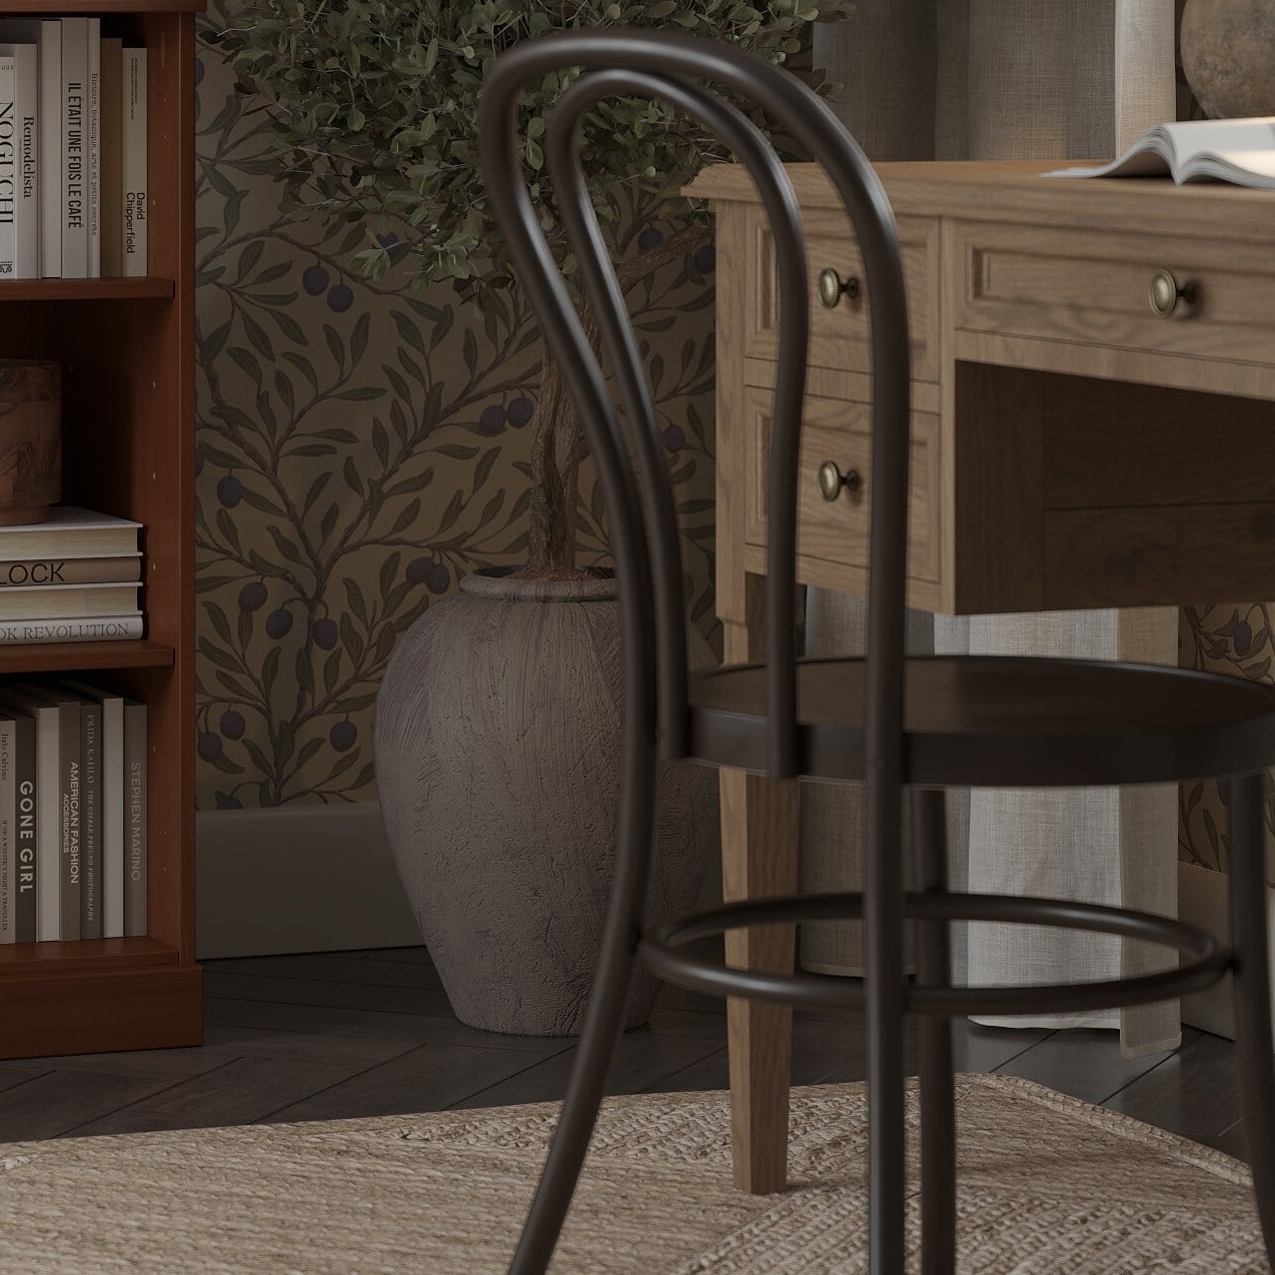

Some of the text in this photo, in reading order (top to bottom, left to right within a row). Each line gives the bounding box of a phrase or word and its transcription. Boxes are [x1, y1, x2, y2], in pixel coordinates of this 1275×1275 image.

[24, 117, 34, 198] Remodelista
[68, 83, 84, 228] IL UNE FOIS LE CAFÉ
[91, 172, 97, 180] et
[125, 192, 135, 253] Chipperfield
[136, 193, 145, 220] David
[24, 623, 129, 640] REVOLUTION
[1, 752, 9, 780] Calvino
[20, 781, 33, 893] GONE GIRL
[70, 762, 78, 883] AMERICAN FASHION
[131, 762, 141, 881] STEPHEN MARINO
